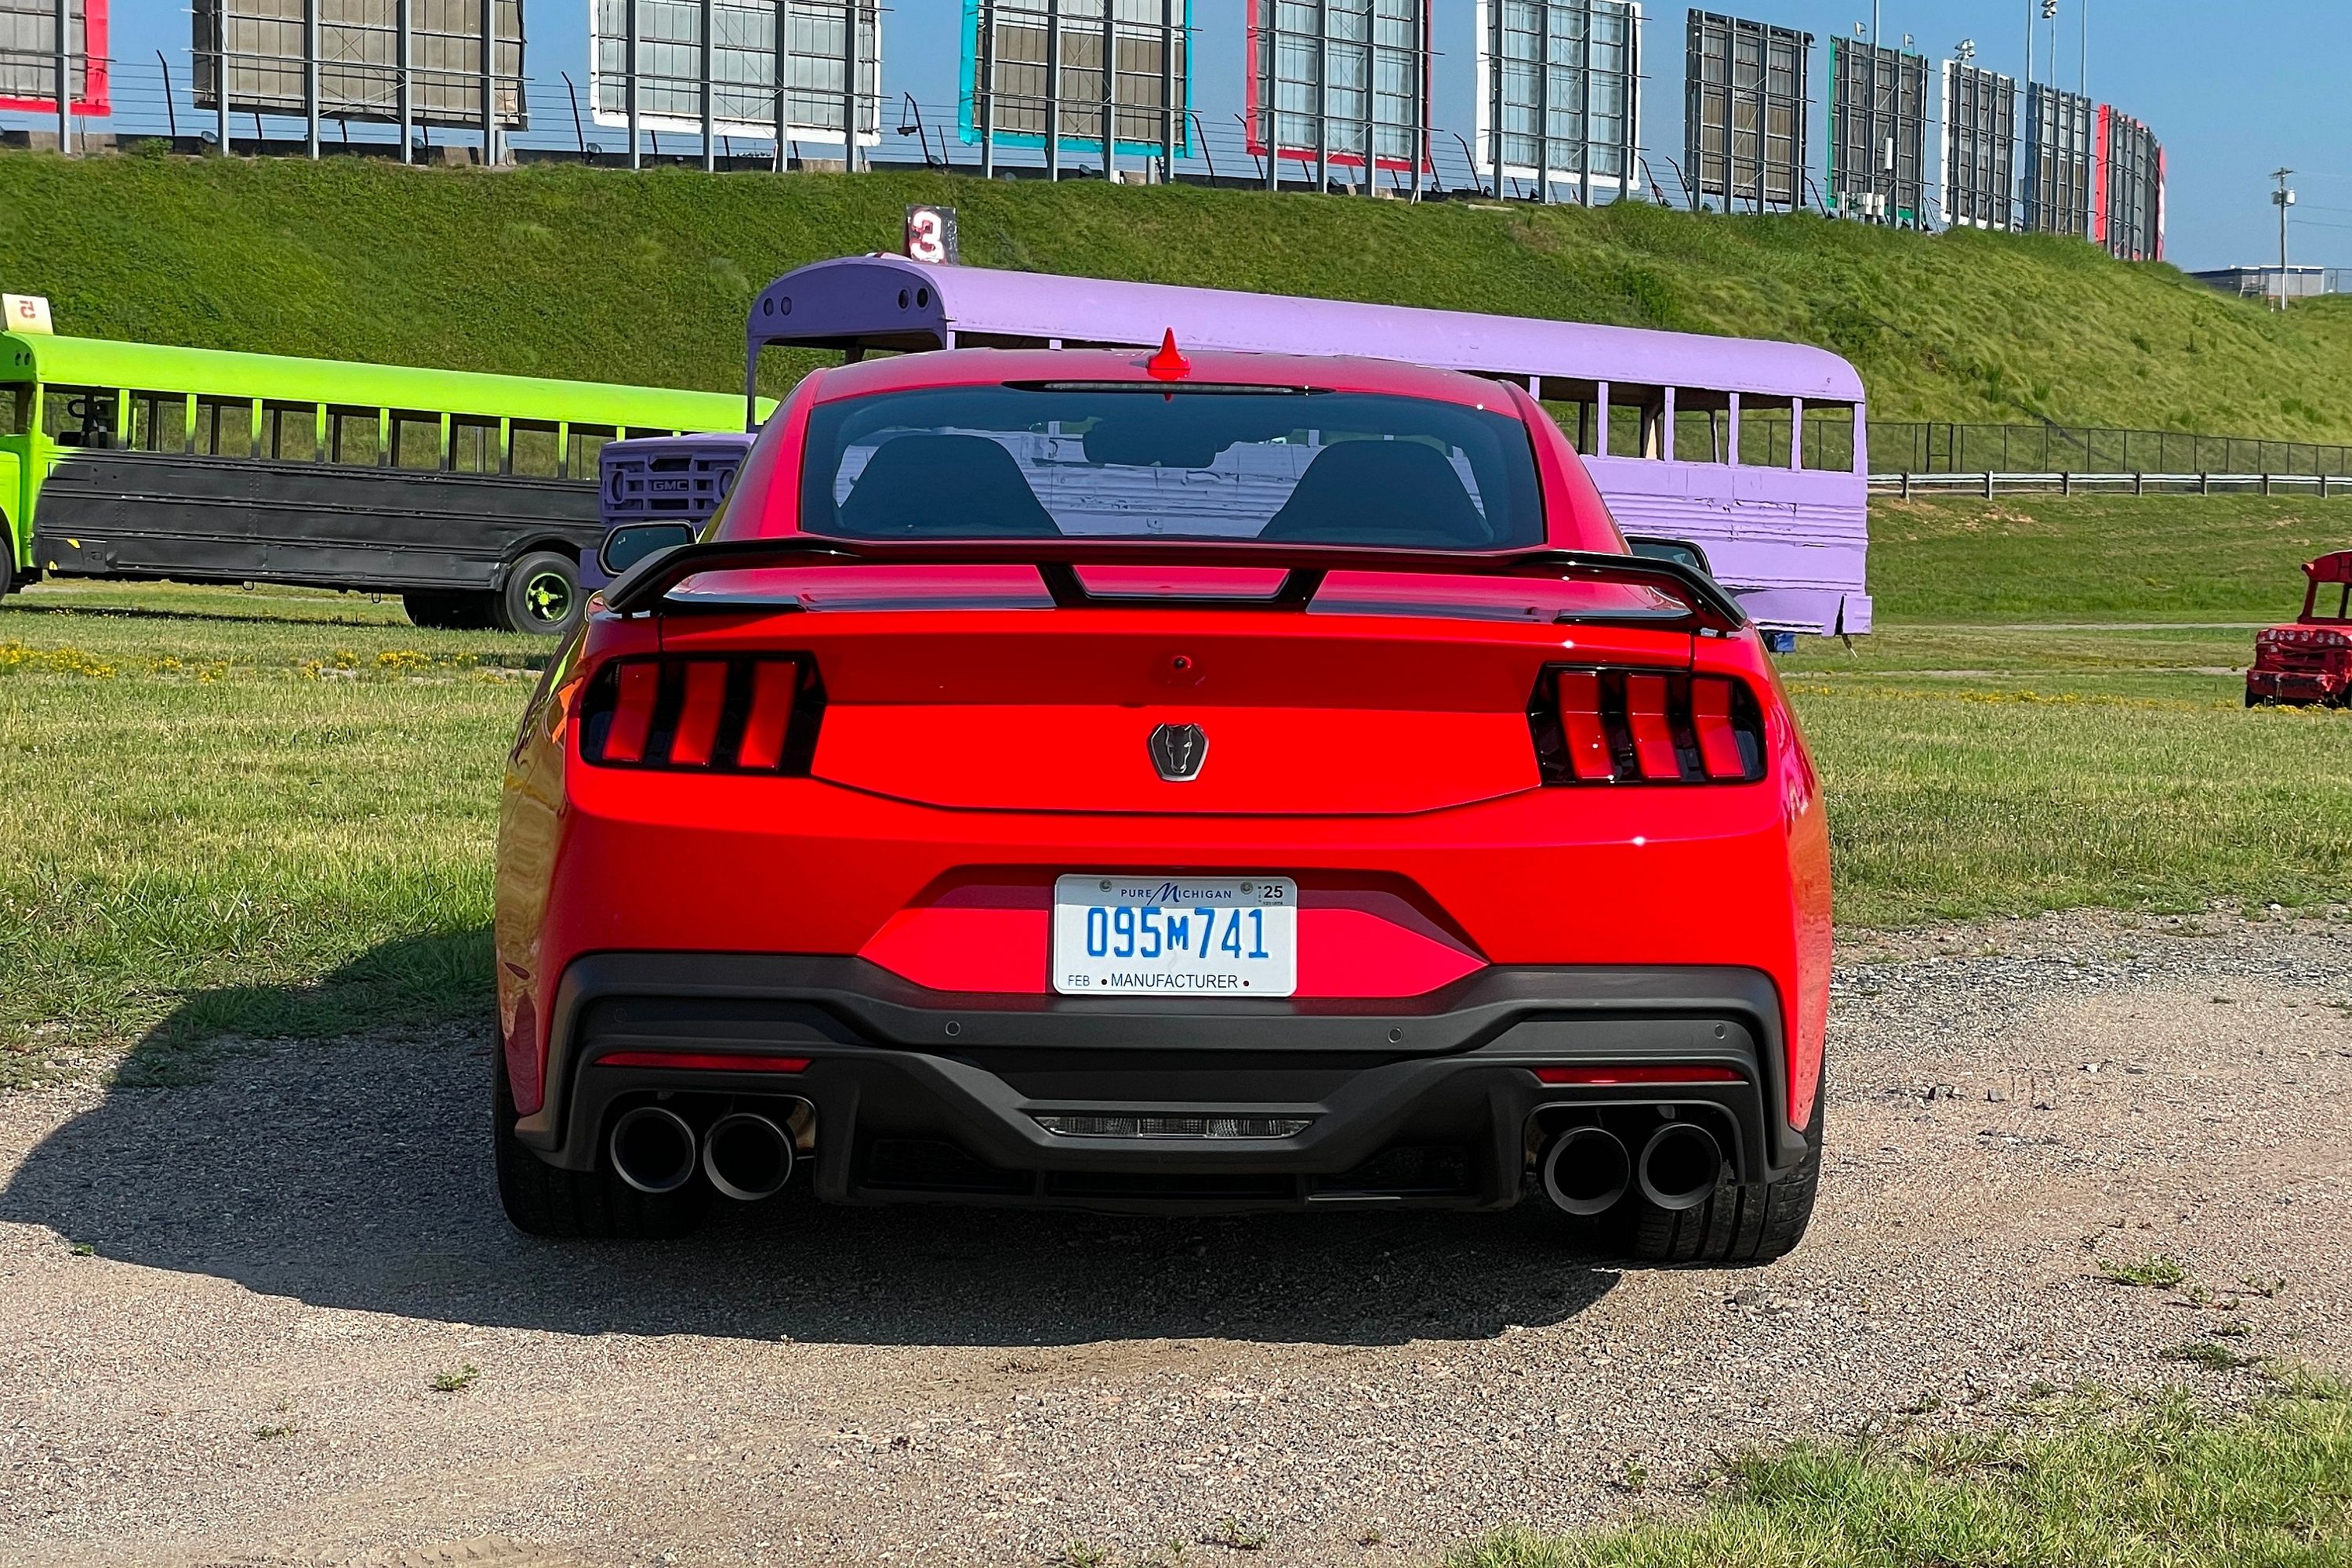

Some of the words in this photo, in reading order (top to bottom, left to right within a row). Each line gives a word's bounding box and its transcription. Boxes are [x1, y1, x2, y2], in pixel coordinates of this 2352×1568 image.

[910, 209, 945, 263] 3
[653, 481, 688, 491] GMC
[1121, 889, 1152, 898] PURE
[1146, 882, 1232, 906] MICHIGAN
[1263, 885, 1283, 898] 25
[1087, 906, 1269, 959] 095M741
[1067, 975, 1090, 986] FEB
[1110, 973, 1238, 989] MANUFACTURER
